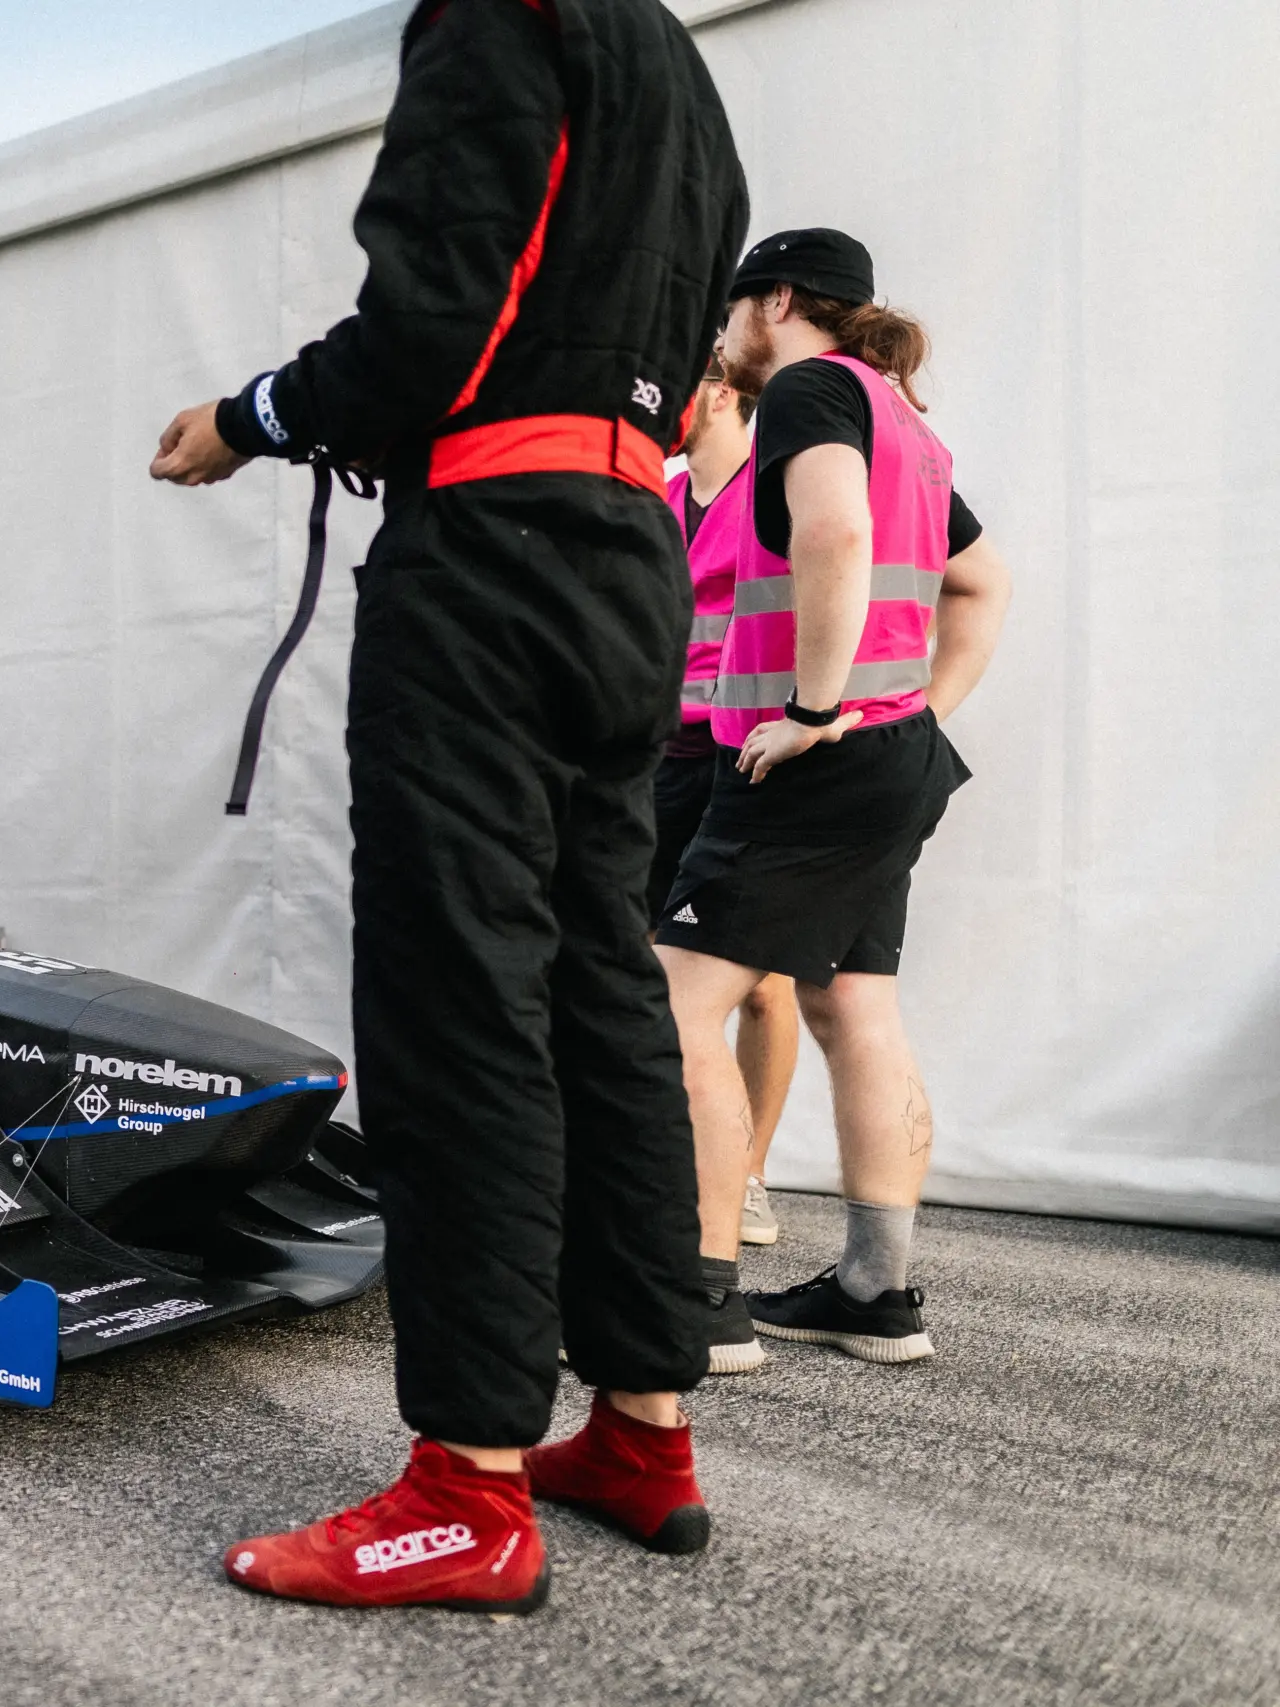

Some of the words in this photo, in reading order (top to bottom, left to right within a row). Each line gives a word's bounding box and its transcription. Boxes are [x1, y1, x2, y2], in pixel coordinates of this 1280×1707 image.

[74, 1053, 242, 1097] norelem
[117, 1115, 163, 1136] Group
[118, 1098, 206, 1120] Hirschvogel
[355, 1523, 475, 1573] sparco
